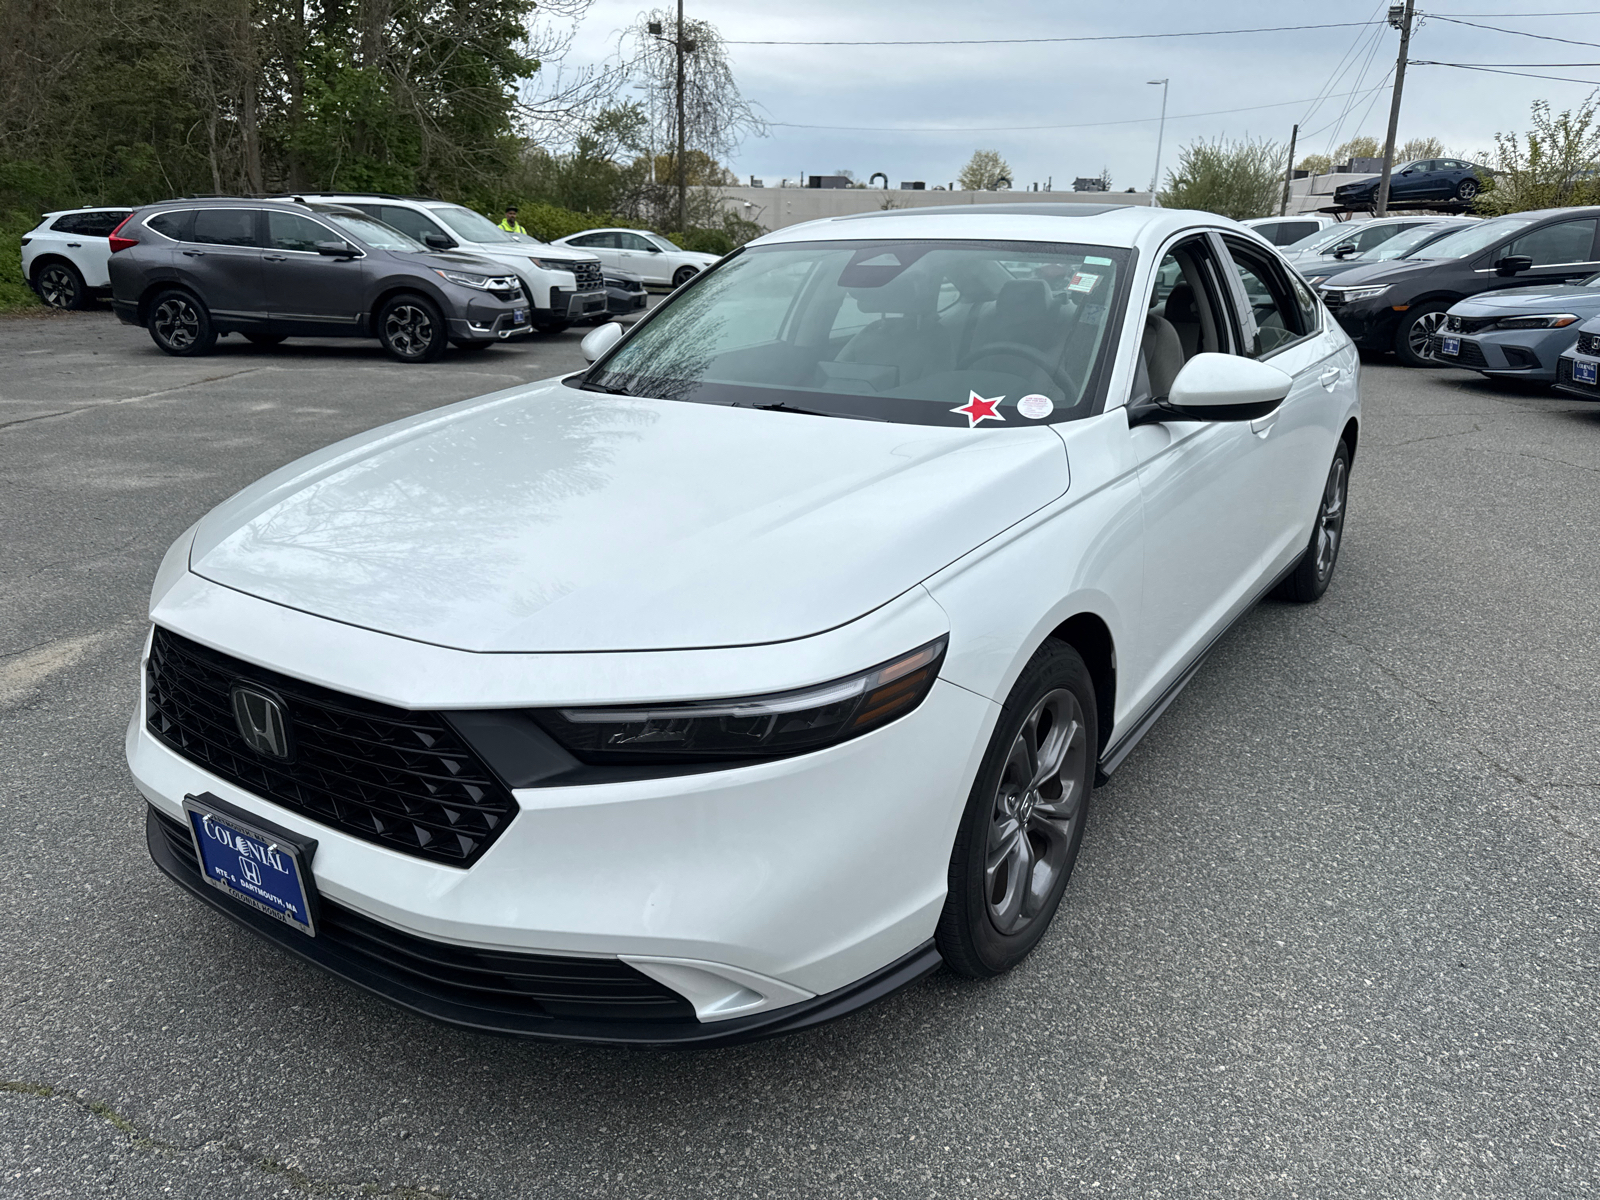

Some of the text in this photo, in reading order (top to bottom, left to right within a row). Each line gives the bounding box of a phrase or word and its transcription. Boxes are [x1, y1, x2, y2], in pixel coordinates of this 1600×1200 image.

[215, 866, 298, 914] RTE. 6 DARTMOUTH, MA
[228, 888, 288, 923] COLONIAL HONDA
